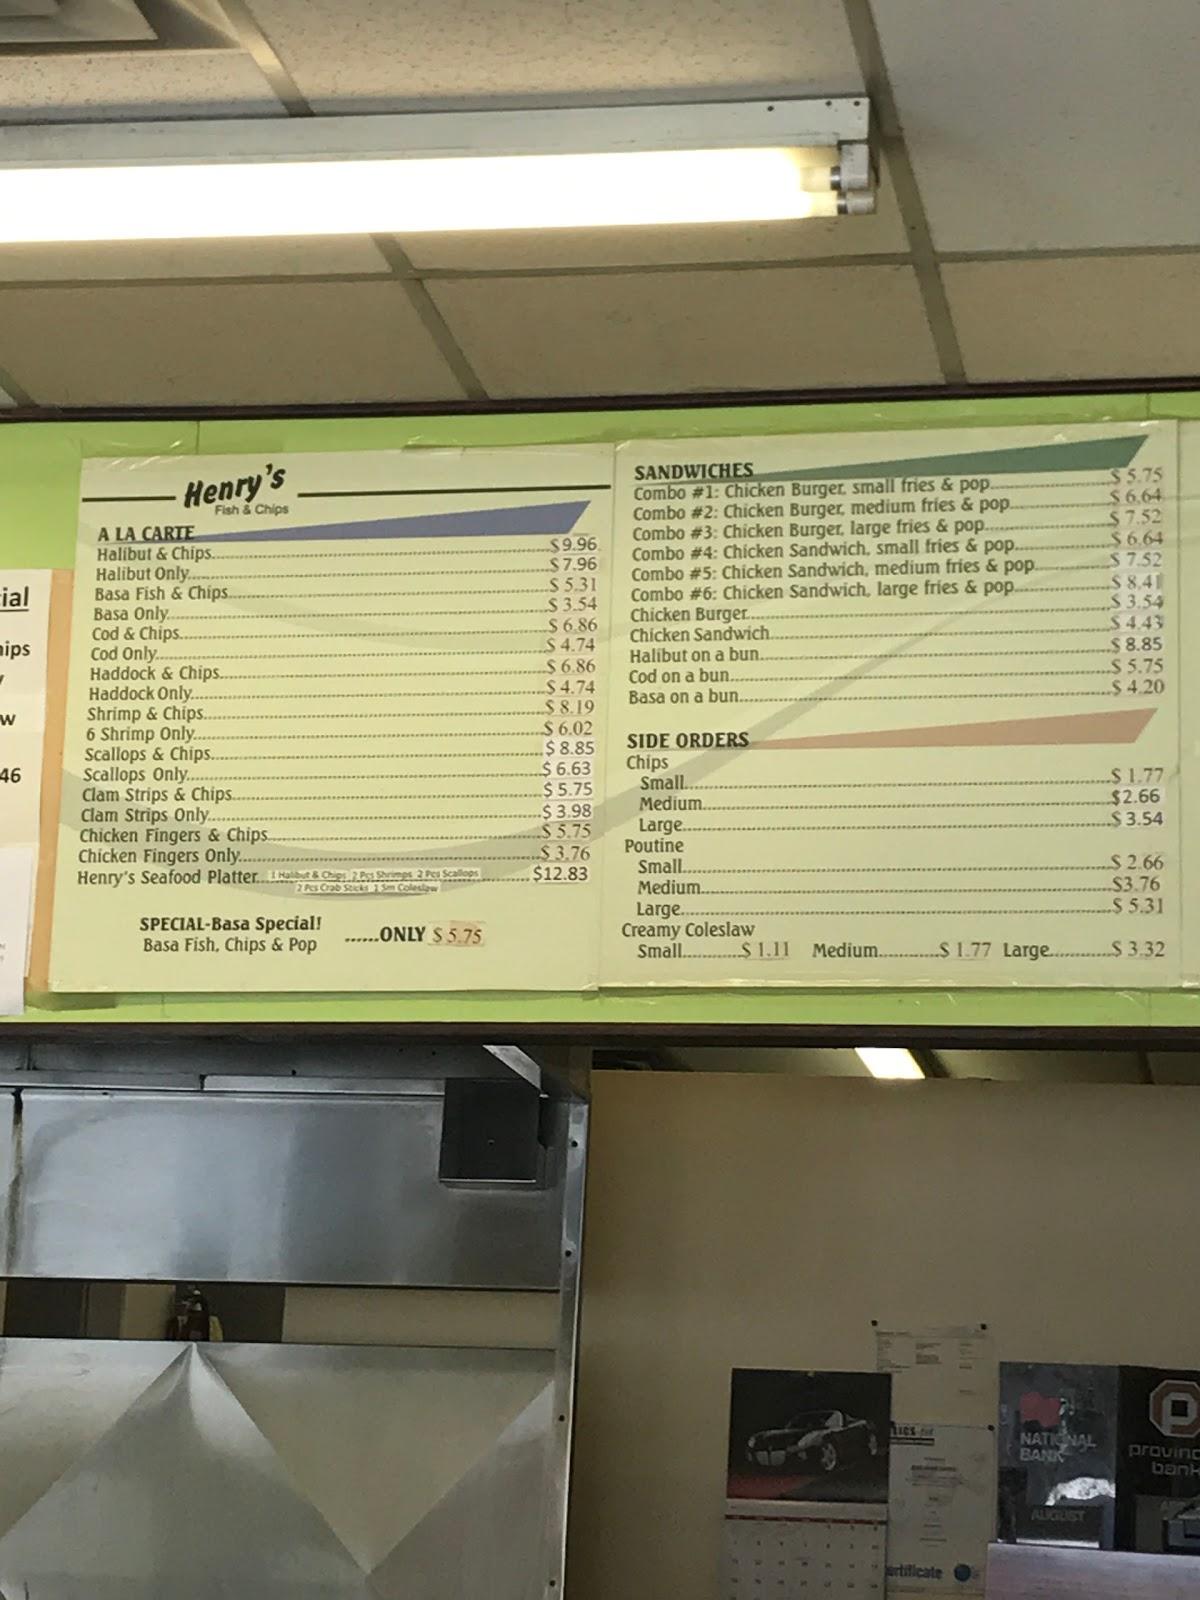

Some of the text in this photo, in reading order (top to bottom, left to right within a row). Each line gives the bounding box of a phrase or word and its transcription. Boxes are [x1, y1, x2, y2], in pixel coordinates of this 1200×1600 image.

[635, 463, 754, 481] SANDWICHES
[184, 463, 286, 508] Henry's
[634, 478, 990, 500] Combo #1: Chicken small fries pop
[215, 504, 289, 516] Fish Chips
[633, 498, 1010, 521] Combo #2: Chicken medium fries pop
[98, 526, 195, 541] A LA CARTE
[633, 519, 984, 541] Combo #3: Chicken large fries pop
[97, 545, 212, 563] Halibut Chips
[632, 539, 1015, 561] Combo #4: Chicken small fries pop
[96, 565, 189, 583] Halibut Only
[632, 559, 1035, 582] Combo #5: Chicken medium fries pop
[0, 586, 29, 606] ial
[95, 585, 228, 602] Basa Fish Chips
[631, 580, 1014, 602] Combo #6: Chicken large fries pop
[94, 606, 168, 623] Basa Only
[631, 608, 748, 623] Chicken Burger
[93, 626, 179, 643] Cod Chips
[630, 626, 770, 643] Chicken Sandwich
[91, 646, 157, 662] Cod Only
[630, 650, 687, 663] Halibut
[729, 647, 759, 661] bun
[90, 665, 220, 682] Haddock Chips
[629, 668, 729, 683] Cod bun
[89, 685, 192, 703] Haddock Only
[629, 689, 739, 704] Basa bun
[88, 700, 594, 723] Shrimp Chips 8.19
[87, 721, 593, 743] 6 Shrimp Only 6.02
[627, 732, 750, 749] SIDE ORDERS
[85, 741, 595, 763] Scallops Chips 8.85
[84, 761, 591, 784] Scallops Only 6.63
[627, 755, 668, 772] Chips
[641, 768, 1164, 790] Small 1.77
[82, 782, 592, 804] Clam Strips Chips 5.75
[639, 788, 1160, 811] Medium $2.66
[81, 803, 592, 824] Clam Strips Only 3.98
[639, 812, 1164, 835] Large 3.54
[80, 823, 591, 845] Chicken Fingers Chips 5.75
[625, 839, 684, 853] Poutine
[79, 845, 590, 866] Chicken Fingers Only 3.76
[638, 854, 1164, 874] Small 2.66
[77, 866, 588, 888] Henry's Seafood Platter $12.83
[638, 876, 1160, 895] Medium $3.76
[637, 898, 1164, 919] Large 5.31
[140, 916, 321, 933] SPECIAL-Basa Special!
[622, 922, 755, 940] Creamy Coleslaw
[380, 927, 482, 944] ONLY 5.75
[144, 938, 317, 954] Basa Fish, Chips Pop
[638, 942, 789, 959] Small 1.11
[813, 942, 992, 958] Medium 1.77
[1004, 942, 1165, 960] Large 3.32
[1020, 1432, 1097, 1448] NATIONAL
[1020, 1448, 1064, 1463] BANK
